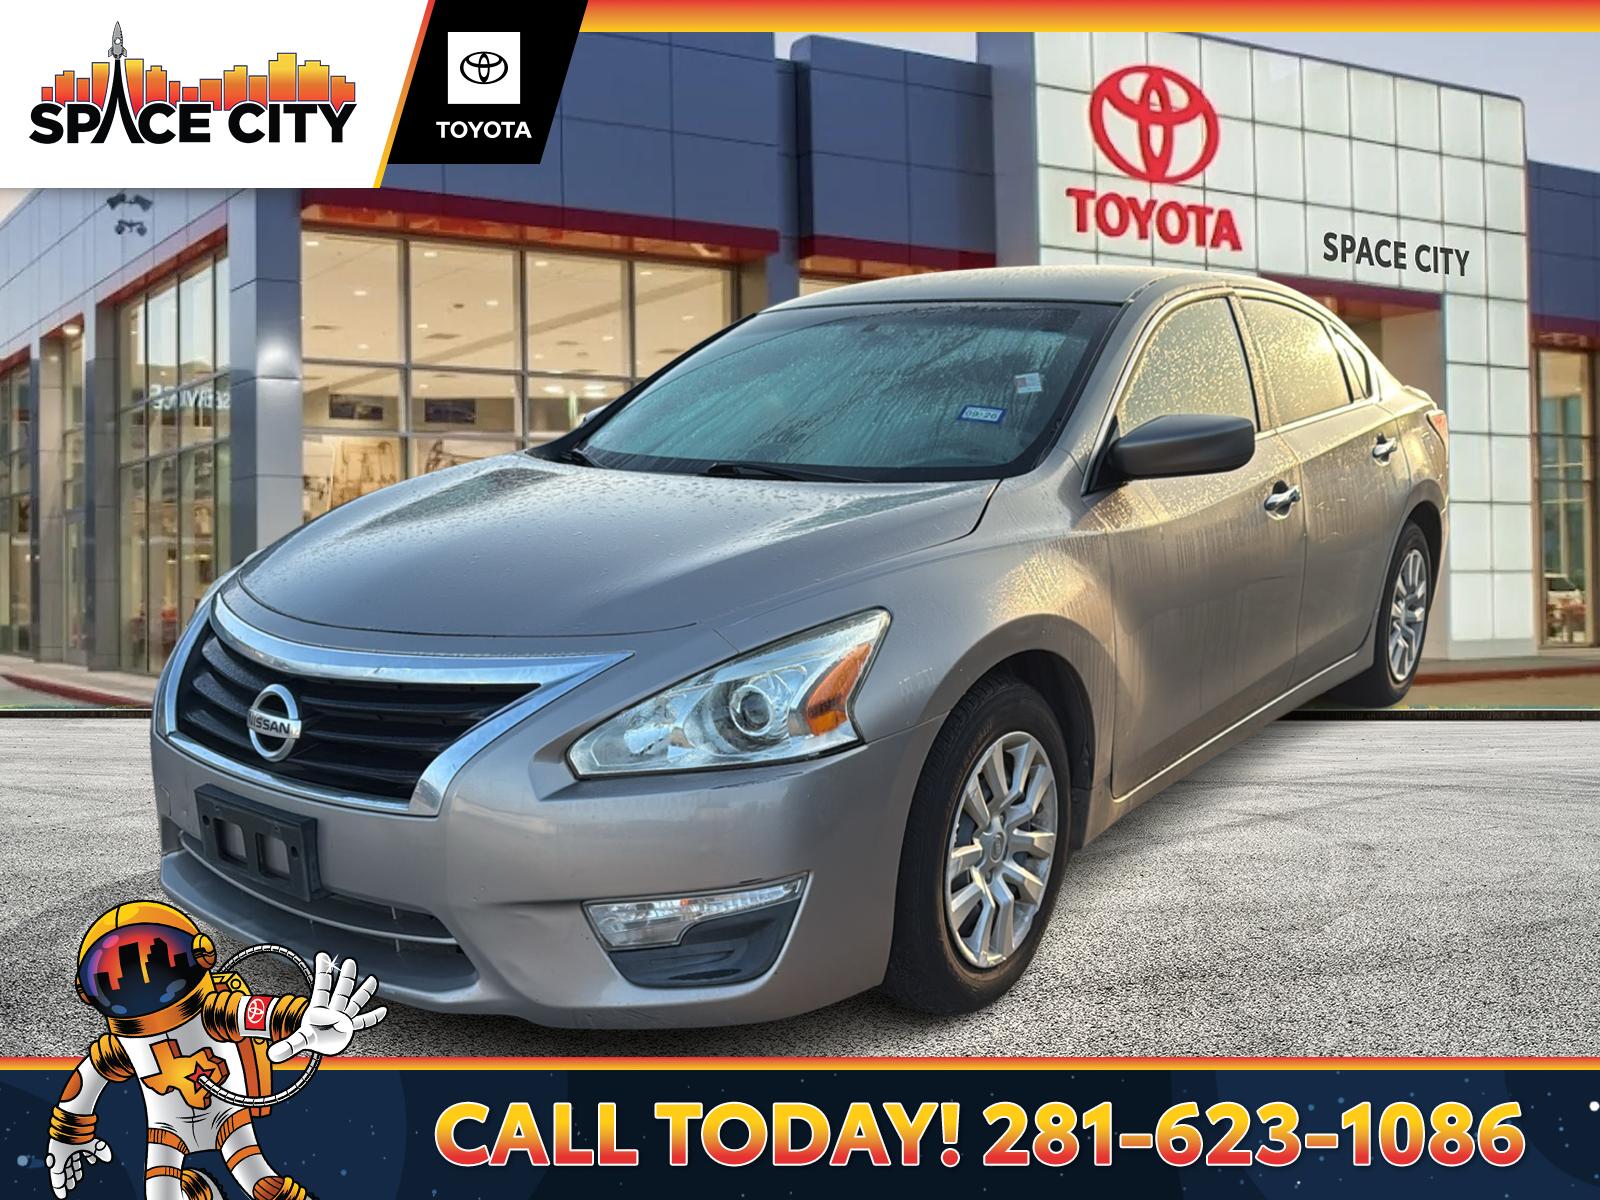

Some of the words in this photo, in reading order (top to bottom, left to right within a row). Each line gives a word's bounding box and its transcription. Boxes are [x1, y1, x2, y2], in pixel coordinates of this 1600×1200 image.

[1066, 187, 1243, 252] TOYOTA
[1323, 231, 1407, 270] SPACE
[1414, 244, 1470, 277] CITY
[249, 712, 290, 734] NISSAN
